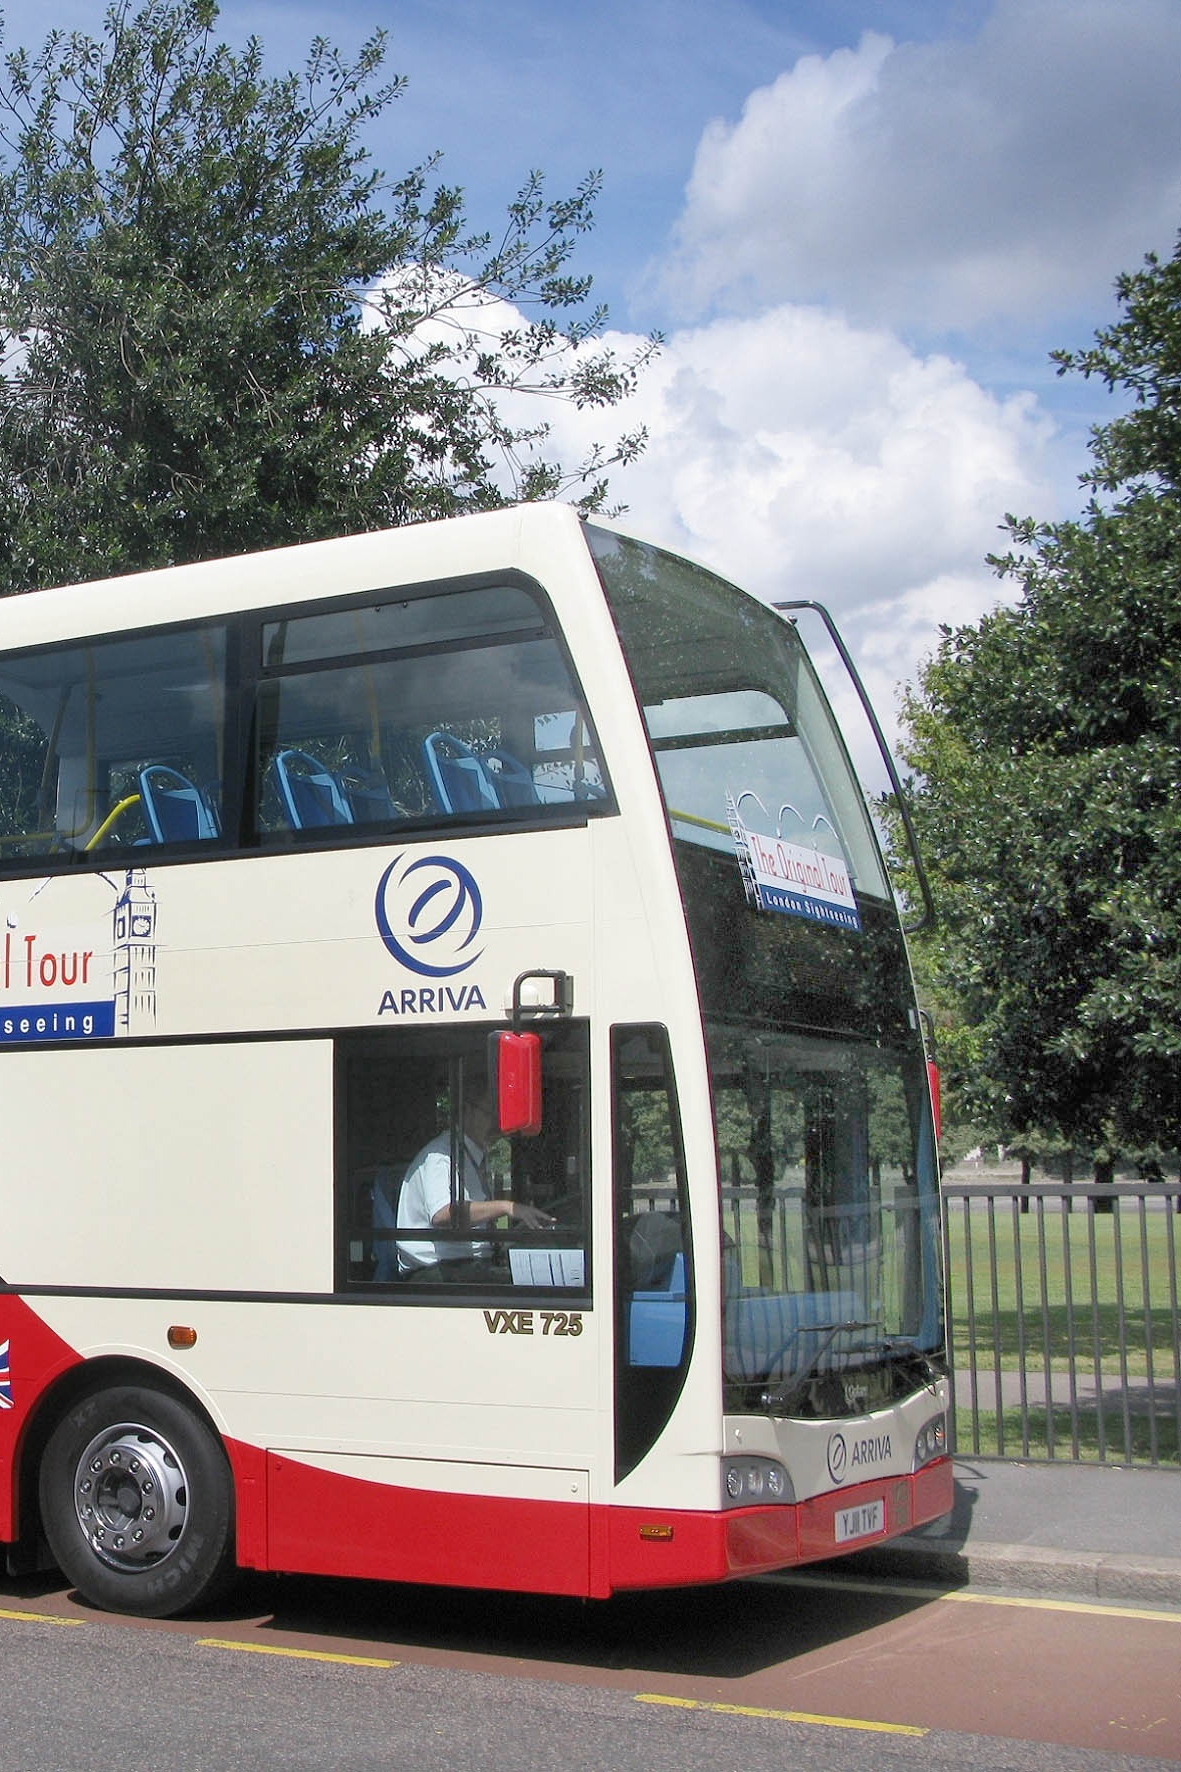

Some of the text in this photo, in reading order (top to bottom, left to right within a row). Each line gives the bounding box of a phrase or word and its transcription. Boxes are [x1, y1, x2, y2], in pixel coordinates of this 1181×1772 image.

[751, 837, 848, 897] The Original Tour
[765, 892, 859, 930] London Sightseeing
[24, 935, 93, 988] Tour
[377, 984, 487, 1016] ARRIVA
[483, 1310, 584, 1337] VXE 725
[851, 1435, 892, 1467] ARRIVA
